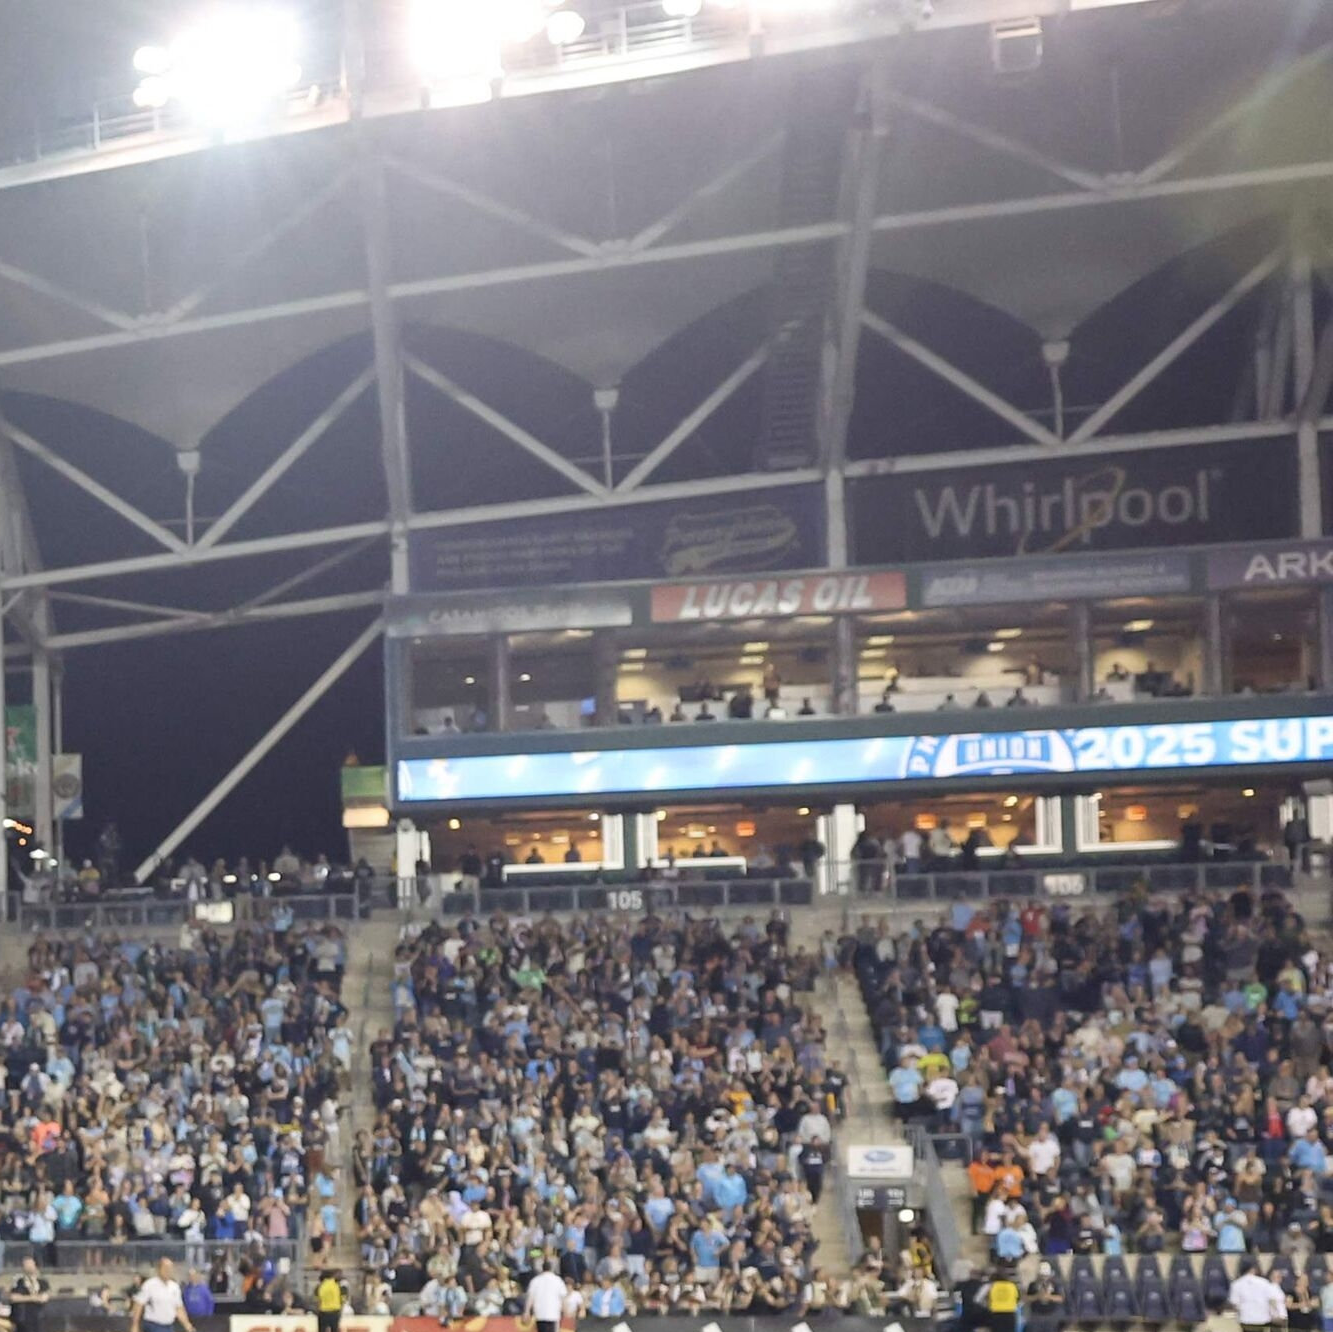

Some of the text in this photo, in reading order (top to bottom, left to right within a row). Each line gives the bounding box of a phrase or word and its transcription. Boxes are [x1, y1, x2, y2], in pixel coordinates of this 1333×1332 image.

[913, 466, 1210, 545] Whirlpool
[679, 575, 874, 619] LUCAS OIL
[1074, 718, 1333, 769] 2025 SUP
[607, 890, 644, 911] 105
